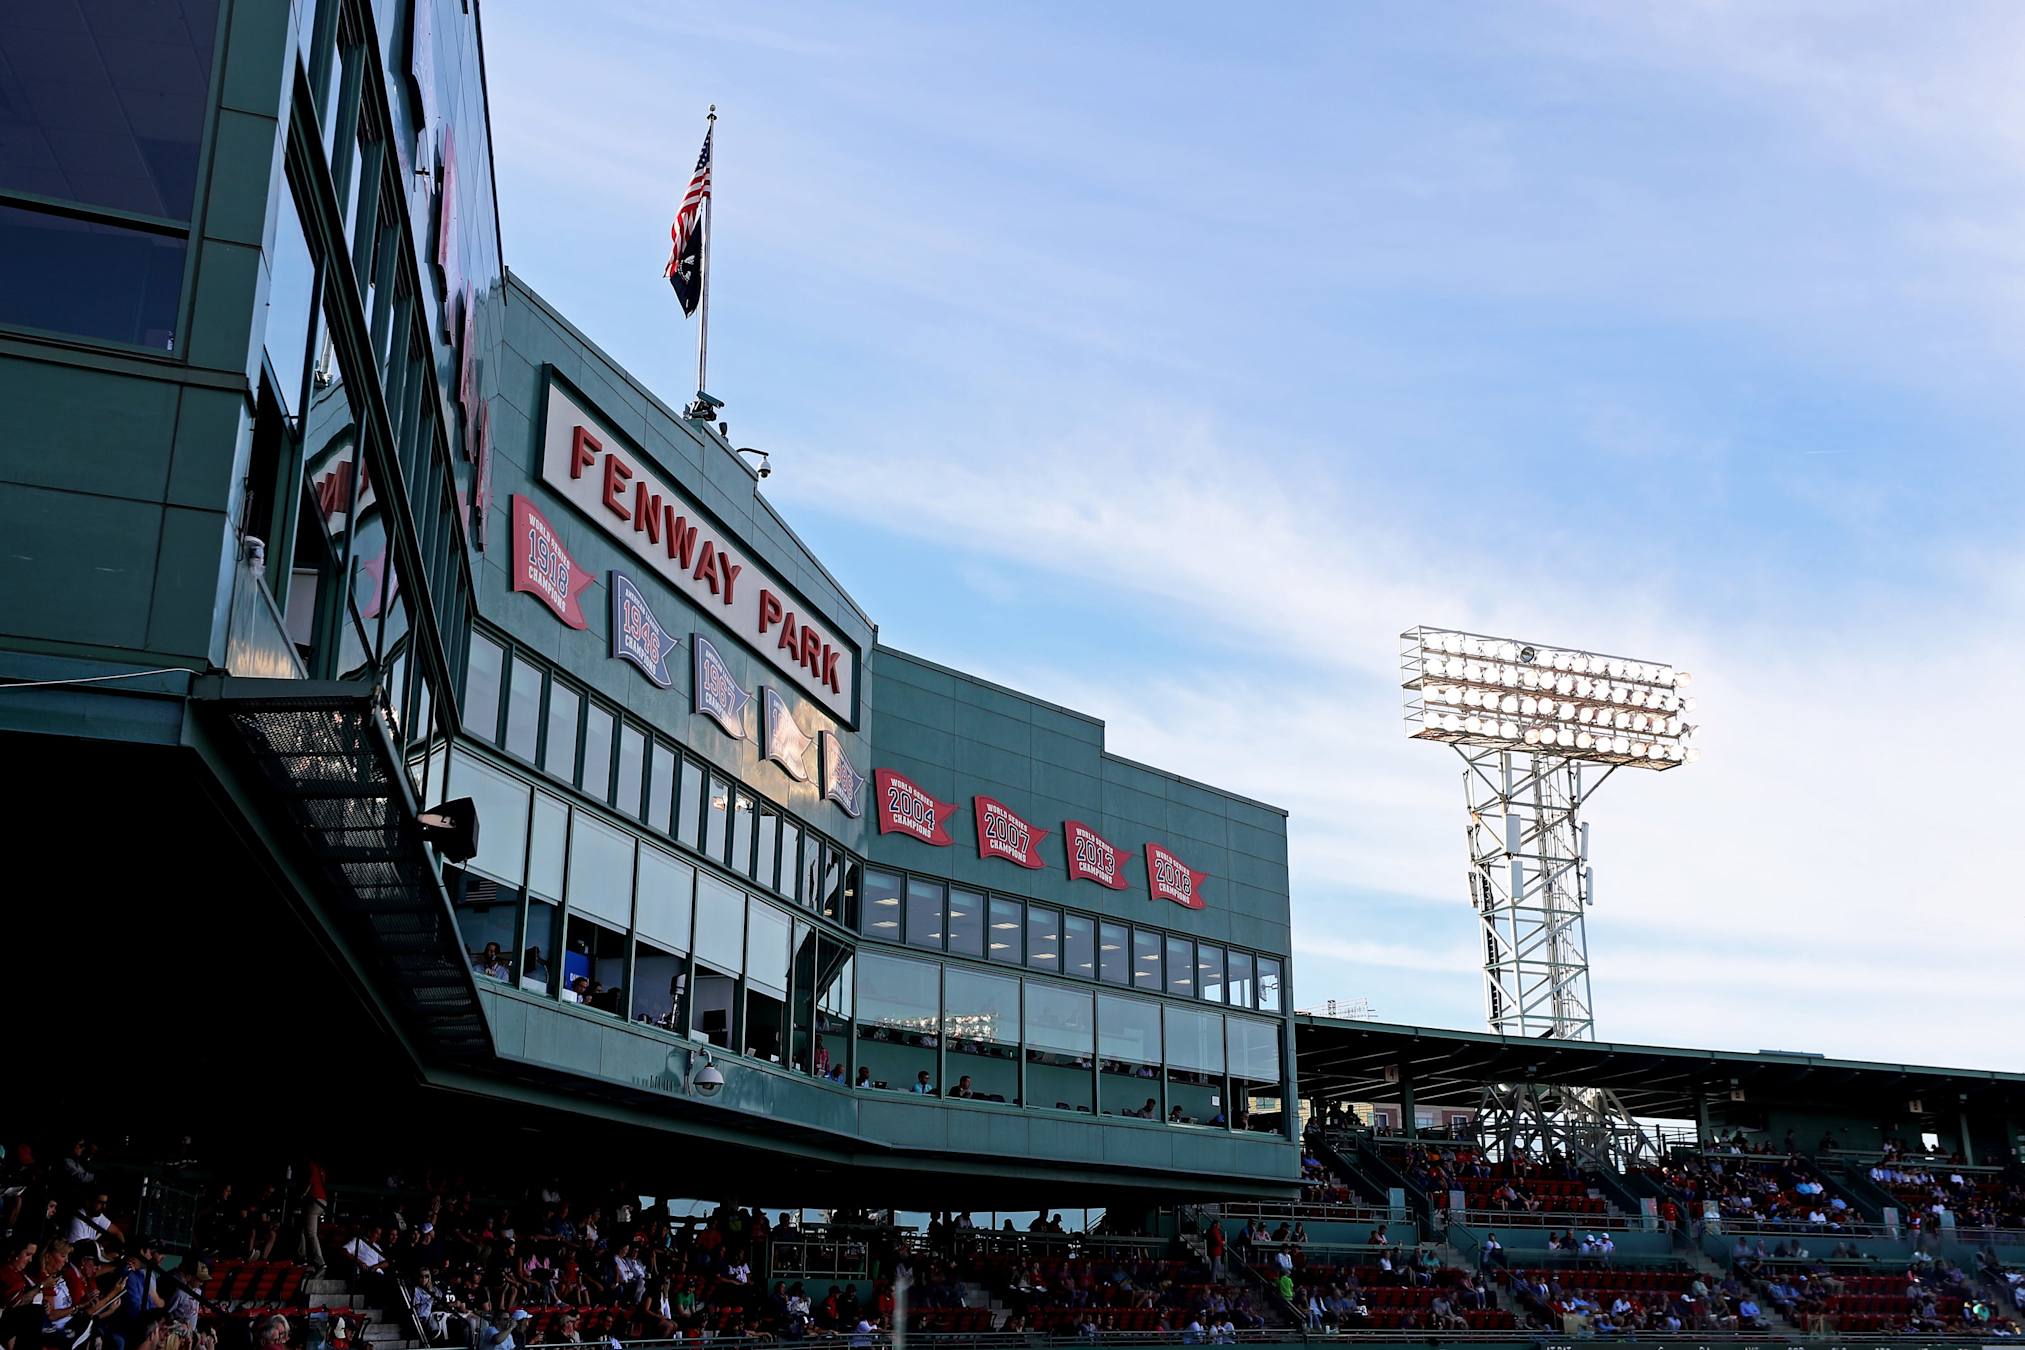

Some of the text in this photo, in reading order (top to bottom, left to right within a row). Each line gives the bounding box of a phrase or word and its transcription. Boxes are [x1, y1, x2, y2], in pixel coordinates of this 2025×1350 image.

[528, 513, 551, 543] WORLD
[528, 528, 569, 598] 1918
[571, 425, 840, 694] FENWAY PARK
[528, 565, 566, 612] CHAMPIONS
[624, 599, 660, 664] 1946
[624, 634, 657, 675] CHAMPIONS
[704, 659, 736, 716] 1967
[891, 778, 913, 794] WORLD
[888, 786, 935, 831] 2004
[893, 813, 931, 838] CHAMPIONS
[986, 803, 1008, 819] WORLD
[984, 812, 1030, 854] 2007
[990, 839, 1027, 863] CHAMPIONS
[1075, 827, 1095, 842] WORLD
[1075, 836, 1115, 876] 2013
[1078, 861, 1113, 884] CHAMPIONS
[1155, 849, 1173, 865] WORLD
[1154, 858, 1192, 897] 2018
[1158, 882, 1190, 904] CHAMPIONS
